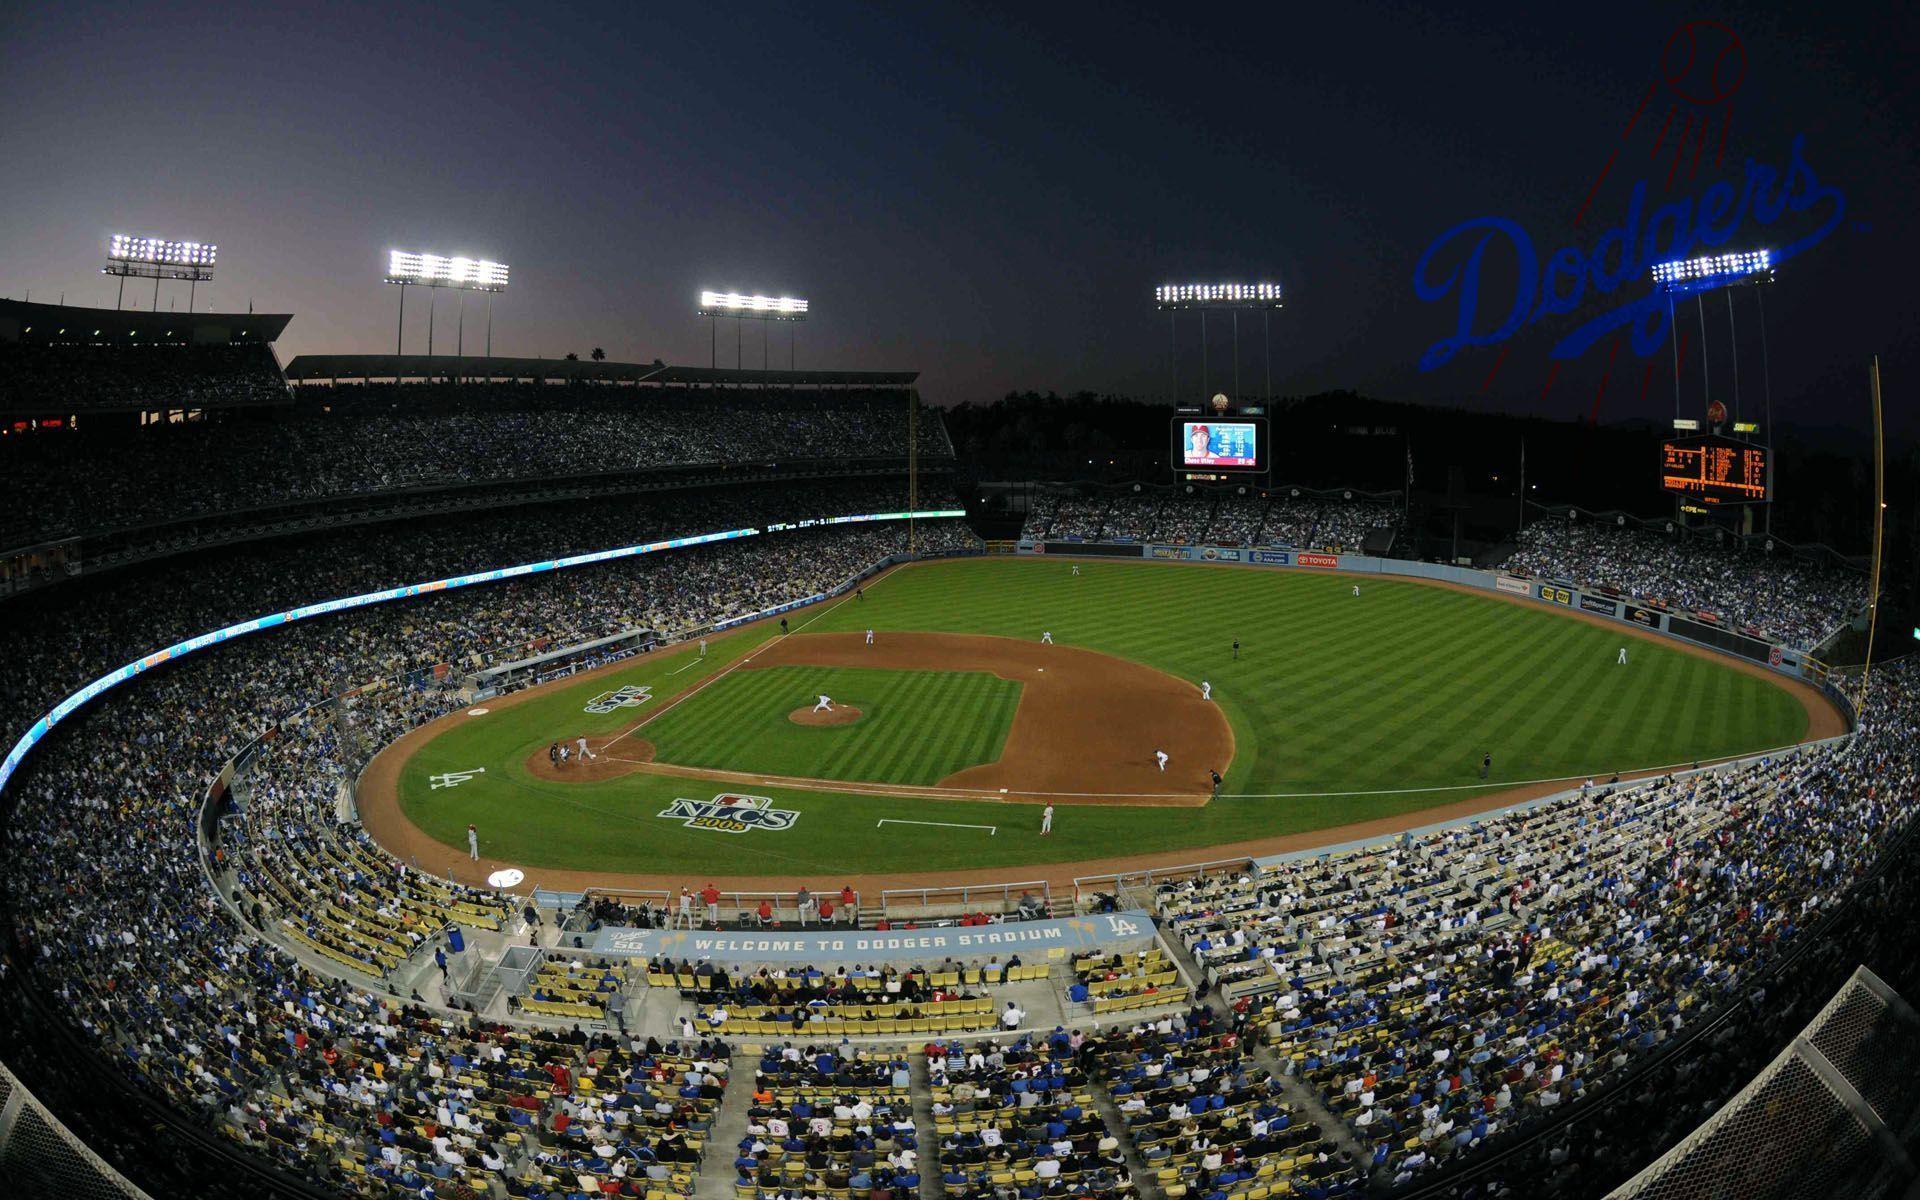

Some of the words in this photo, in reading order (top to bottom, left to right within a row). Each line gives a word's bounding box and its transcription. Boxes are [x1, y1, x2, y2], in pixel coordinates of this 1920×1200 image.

[1309, 557, 1337, 565] TOYOTA
[662, 799, 796, 829] NLCS
[693, 816, 748, 831] 2008
[1105, 915, 1139, 937] LA
[613, 941, 643, 950] 50
[695, 939, 805, 951] WELCOME
[817, 940, 844, 951] TO
[856, 936, 946, 950] DODGER
[959, 927, 1062, 946] STADIUM
